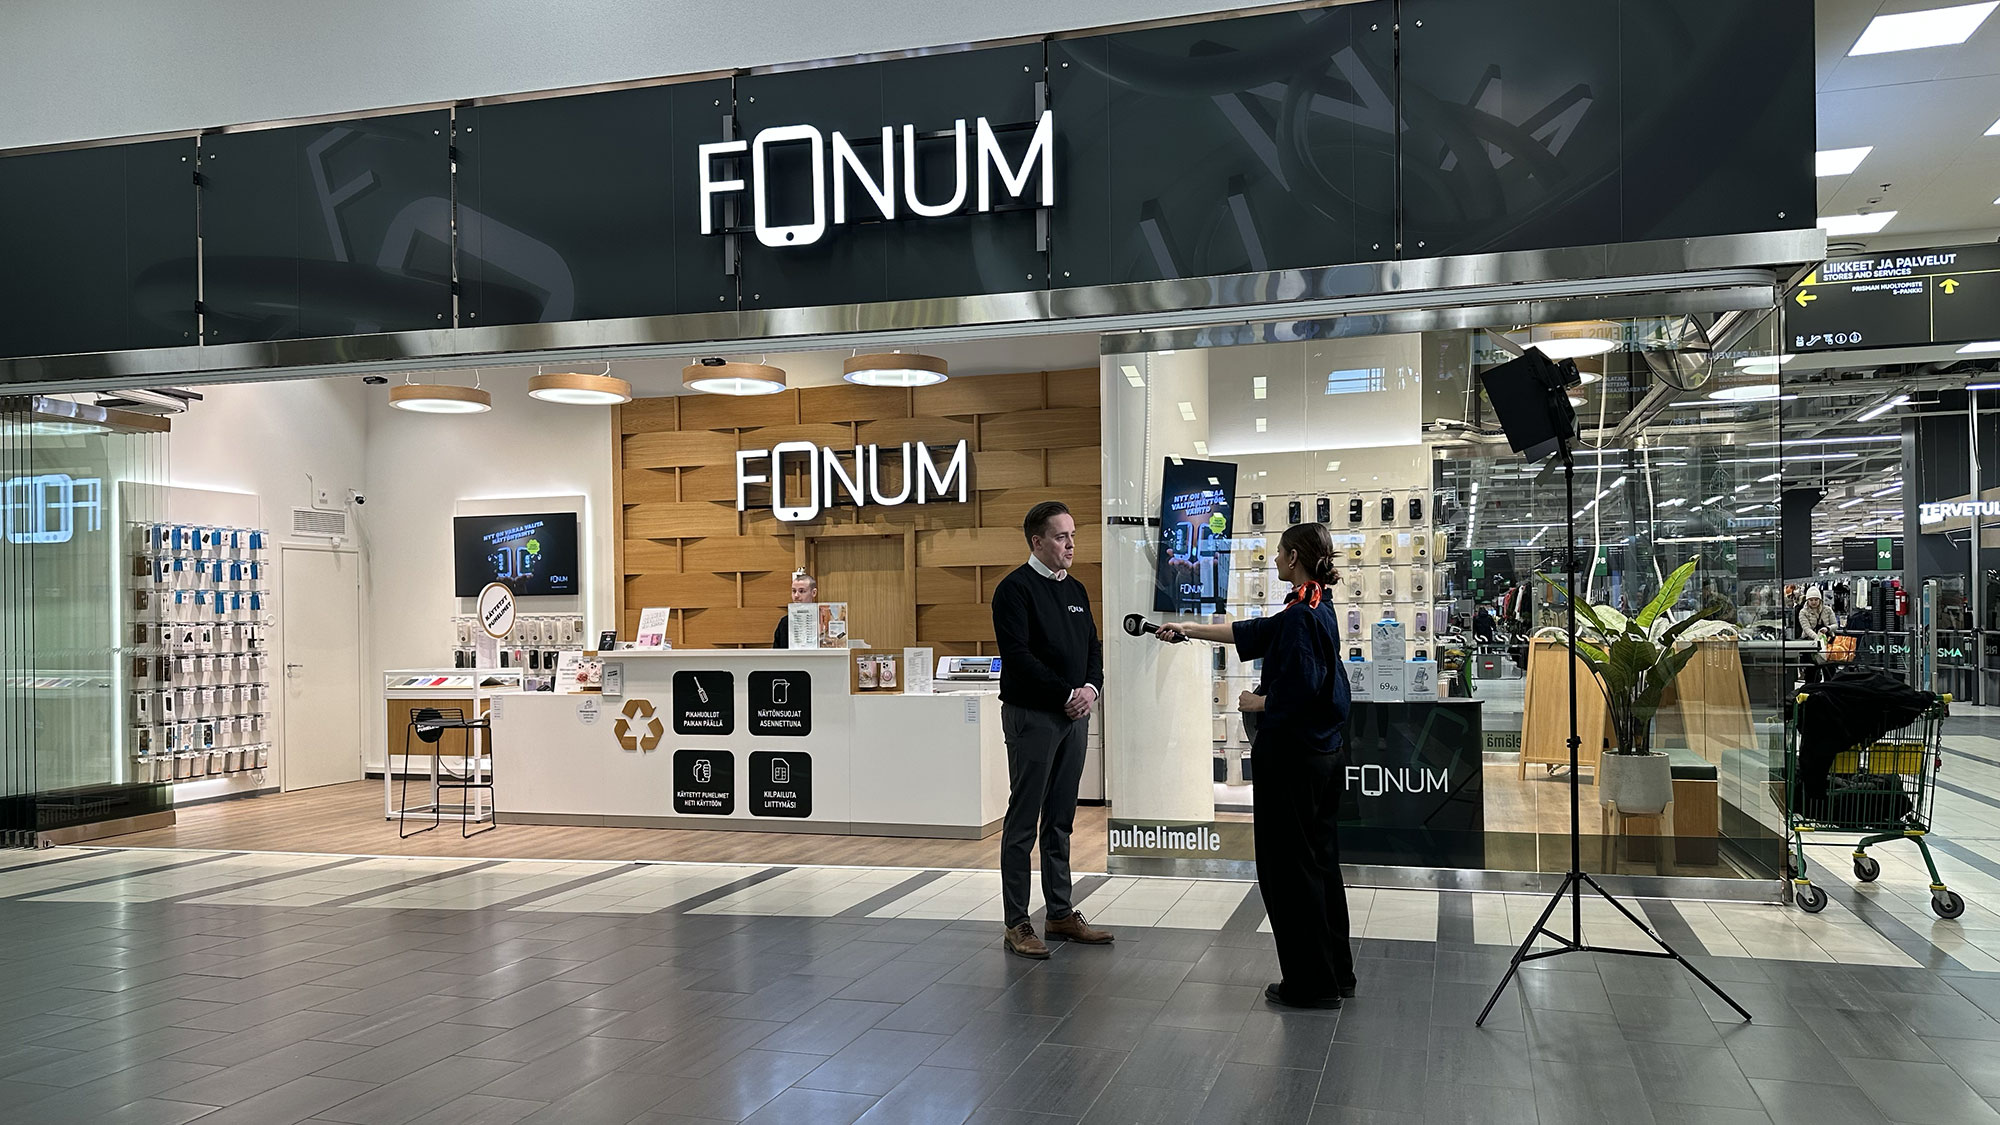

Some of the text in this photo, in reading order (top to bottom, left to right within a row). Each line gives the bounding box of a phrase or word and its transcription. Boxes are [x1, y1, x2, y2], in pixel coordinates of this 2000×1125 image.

[699, 110, 1053, 247] FONUM
[1823, 253, 1957, 274] LIIKKEET JA PALVELUT
[1823, 268, 1912, 282] STORES AND SERVICES
[1852, 281, 1923, 292] PRISMAN HUOLTOPISTE
[736, 439, 967, 522] FONUM
[1174, 494, 1190, 502] NYT
[1172, 500, 1195, 510] VALITA
[1185, 506, 1211, 516] VAIHTO
[484, 533, 496, 542] NYT
[504, 526, 524, 535] VARAA
[524, 520, 544, 530] VALITA
[1180, 584, 1204, 594] FONUM
[485, 594, 508, 621] KÄYTETYT
[488, 601, 512, 628] PUHELIMET
[758, 709, 802, 718] NÄYTÖNSUOJAT
[703, 718, 723, 727] PÄÄLLÄ
[1345, 764, 1448, 797] FONUM
[696, 799, 722, 807] KÄYTTÖÖN
[764, 800, 796, 809] LIITTYMÄSI
[1109, 824, 1220, 852] puhelimelle
